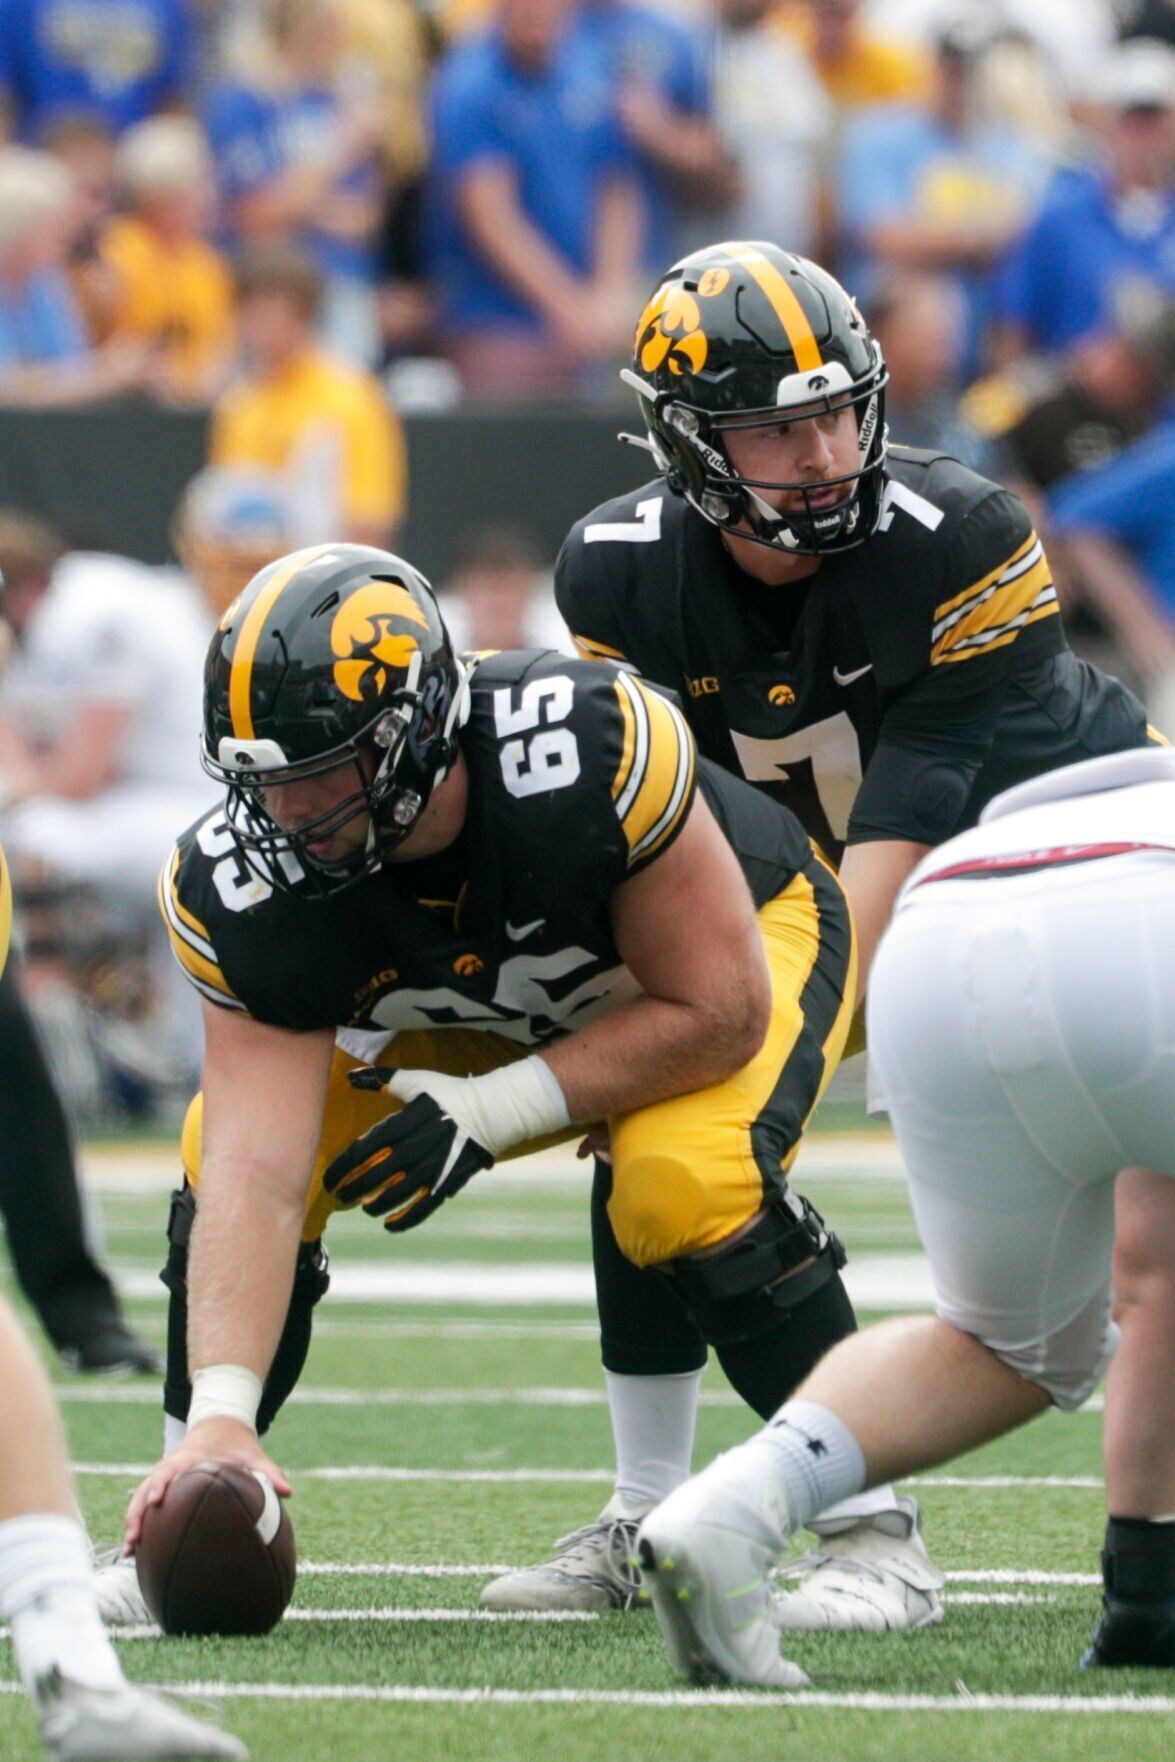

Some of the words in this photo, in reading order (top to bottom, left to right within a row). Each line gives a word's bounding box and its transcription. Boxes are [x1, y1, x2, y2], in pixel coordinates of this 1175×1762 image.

[858, 402, 878, 451] Riddell
[583, 496, 663, 544] 7
[879, 479, 945, 532] 7
[493, 675, 581, 799] 65
[729, 710, 863, 842] 7
